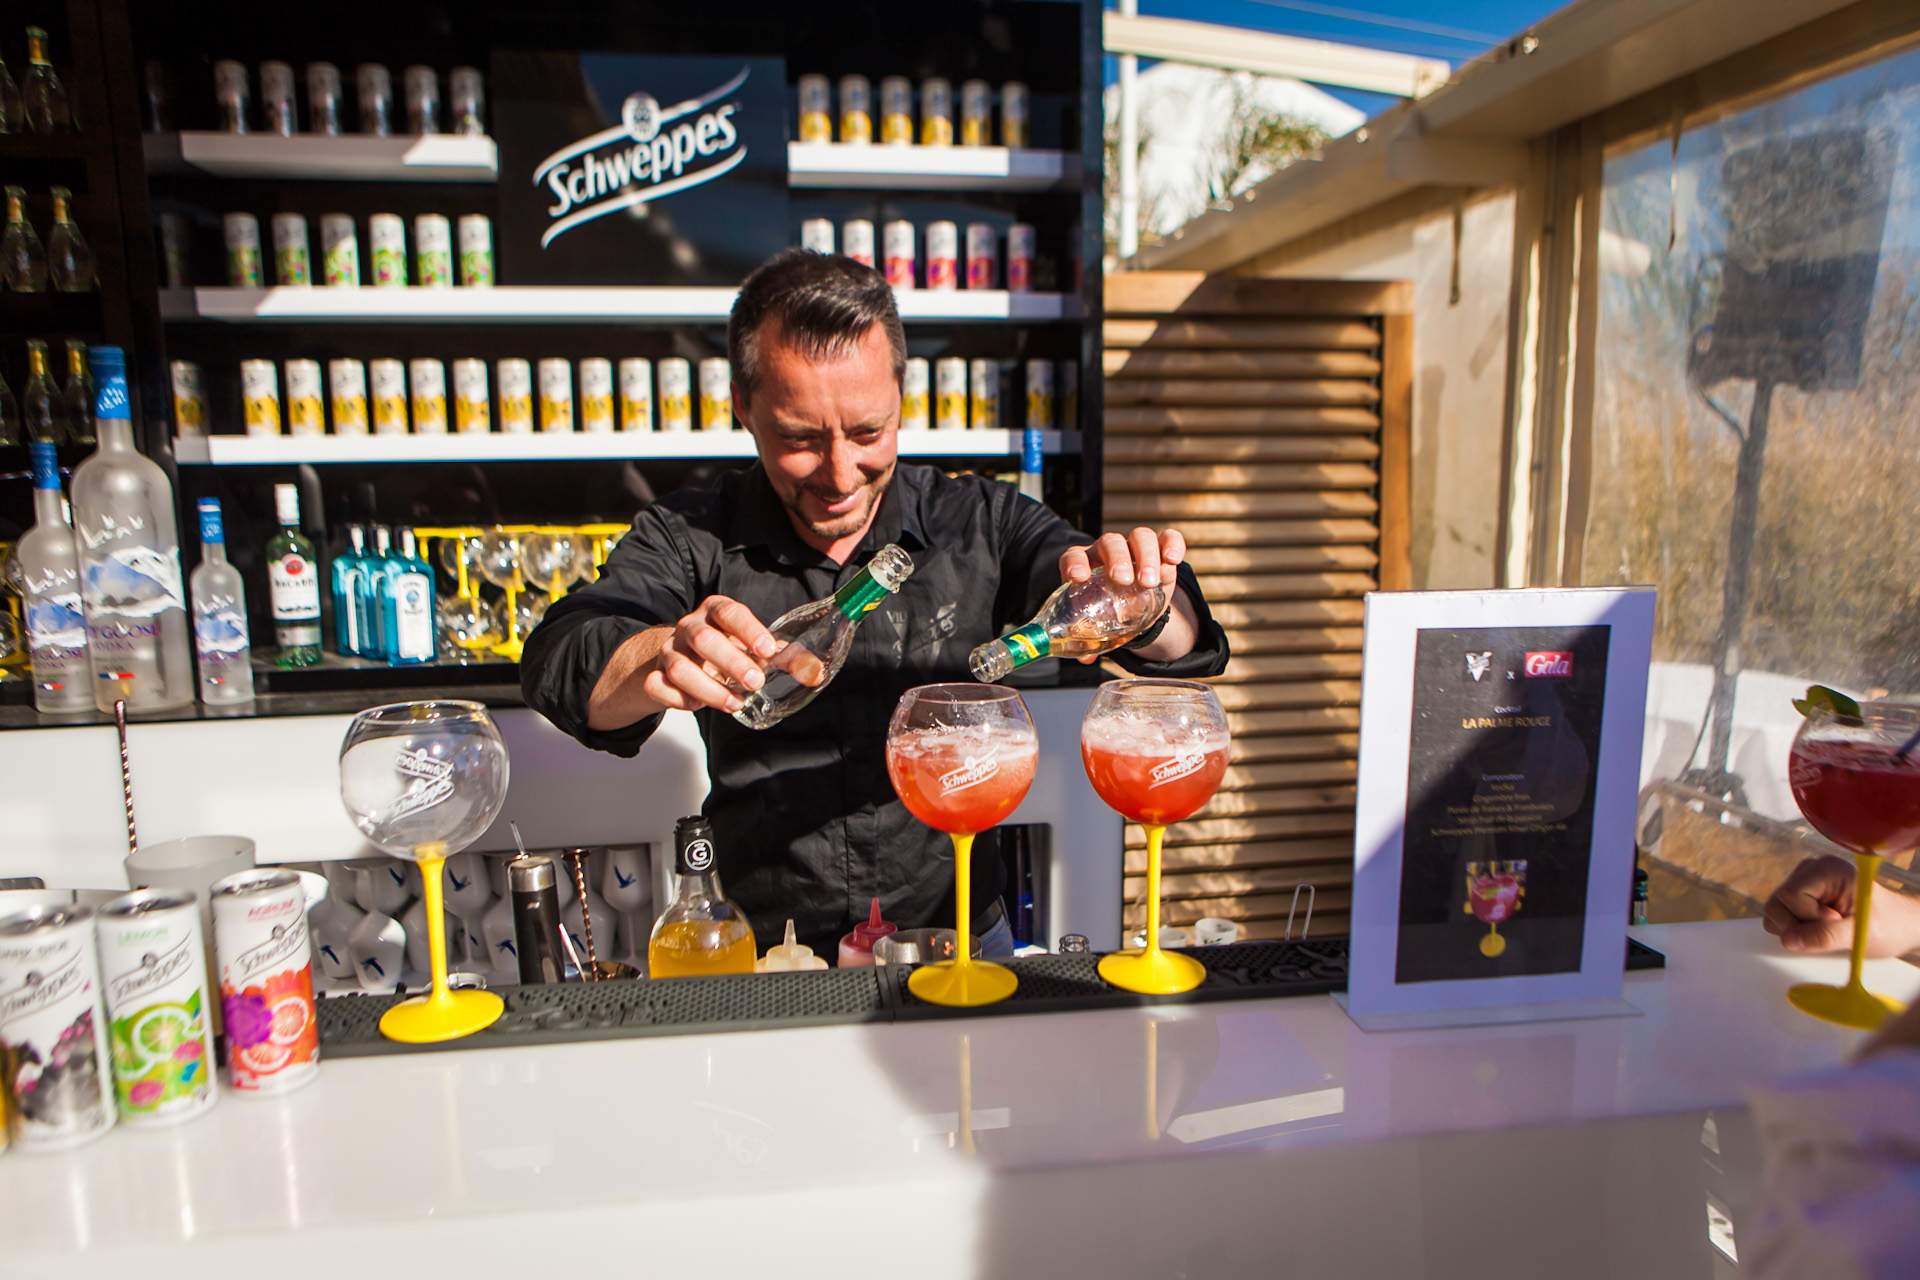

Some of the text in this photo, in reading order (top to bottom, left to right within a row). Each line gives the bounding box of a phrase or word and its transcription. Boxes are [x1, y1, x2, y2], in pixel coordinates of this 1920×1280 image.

[547, 104, 737, 217] Schweppes
[1526, 655, 1569, 676] Gala
[1462, 716, 1552, 729] LA PALME ROUGE
[943, 759, 998, 790] Schweppes
[1152, 752, 1204, 782] Schweppes
